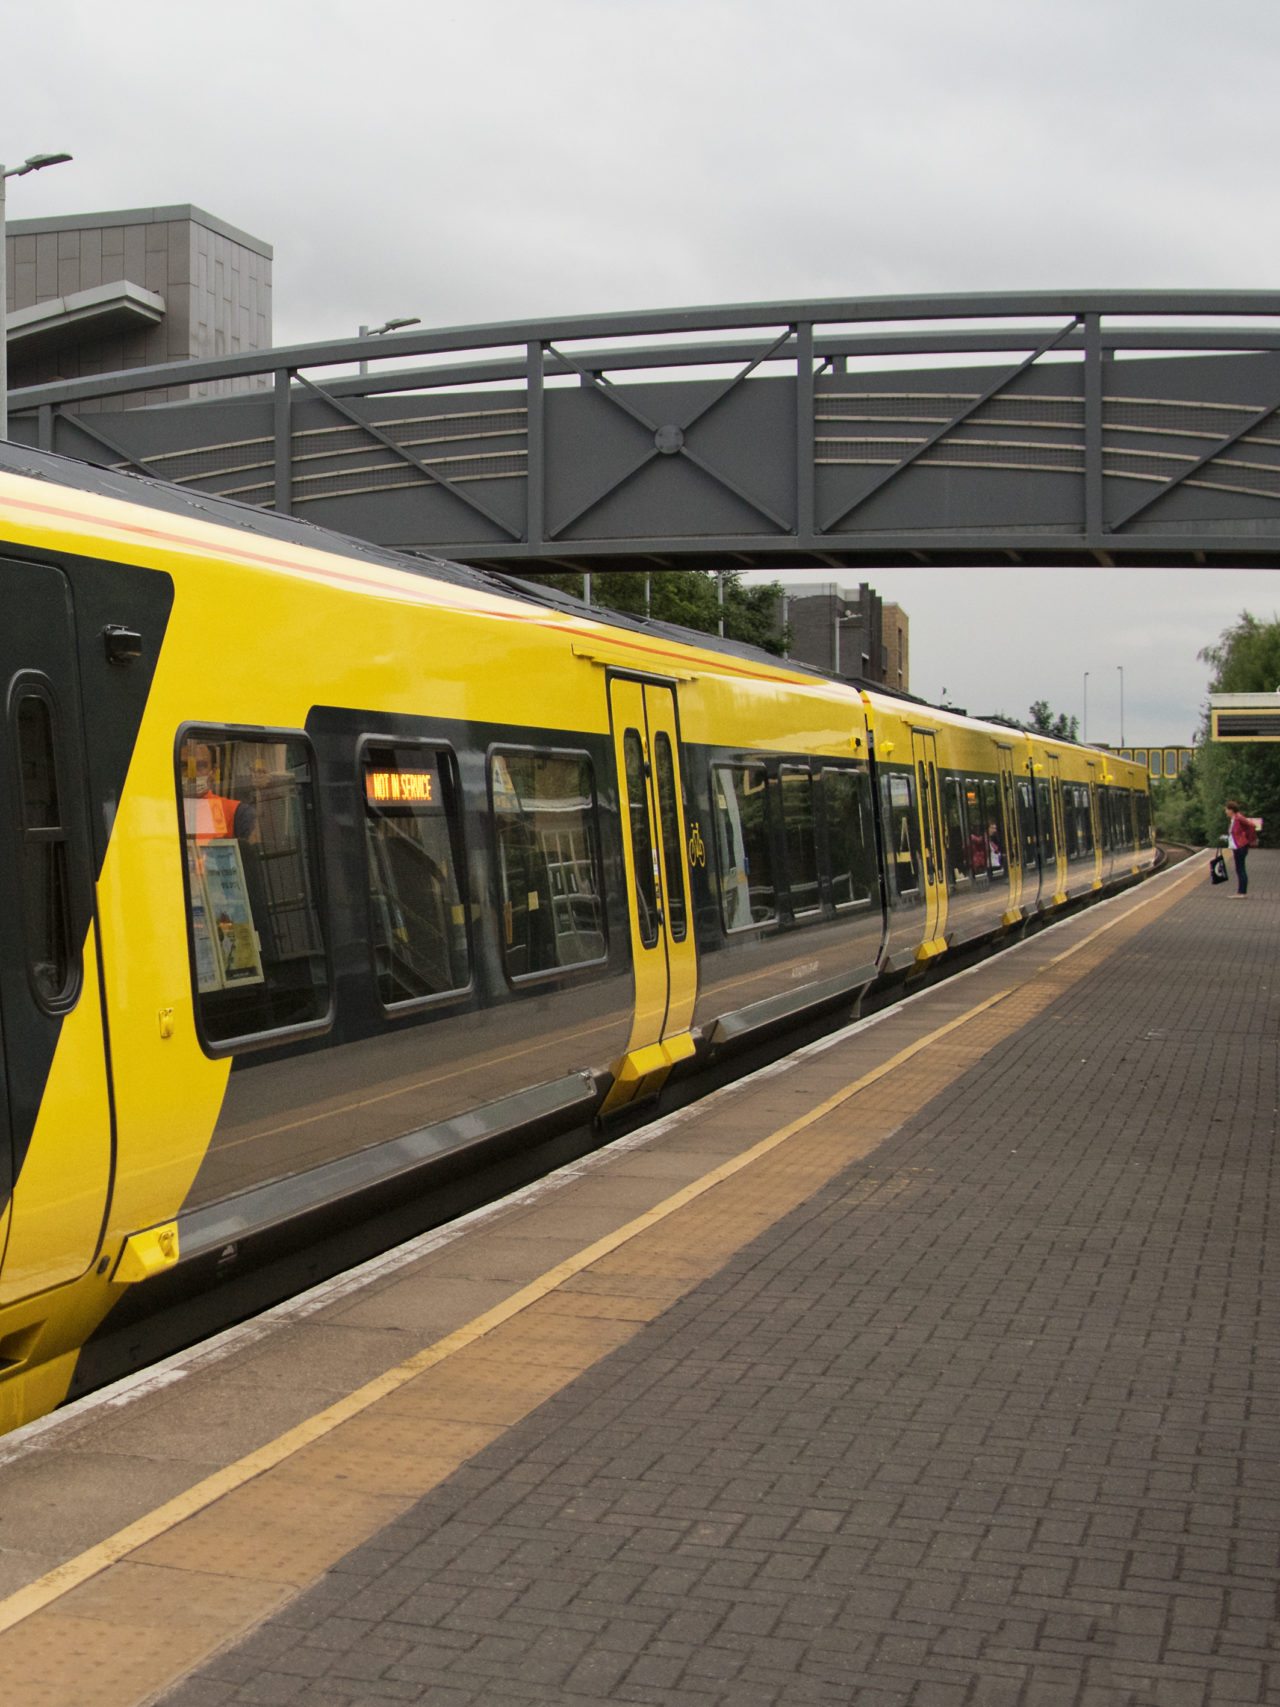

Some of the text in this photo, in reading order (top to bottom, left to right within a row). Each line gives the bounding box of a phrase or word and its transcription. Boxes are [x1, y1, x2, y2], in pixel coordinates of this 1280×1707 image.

[373, 773, 432, 800] NOT IN SERVICE
